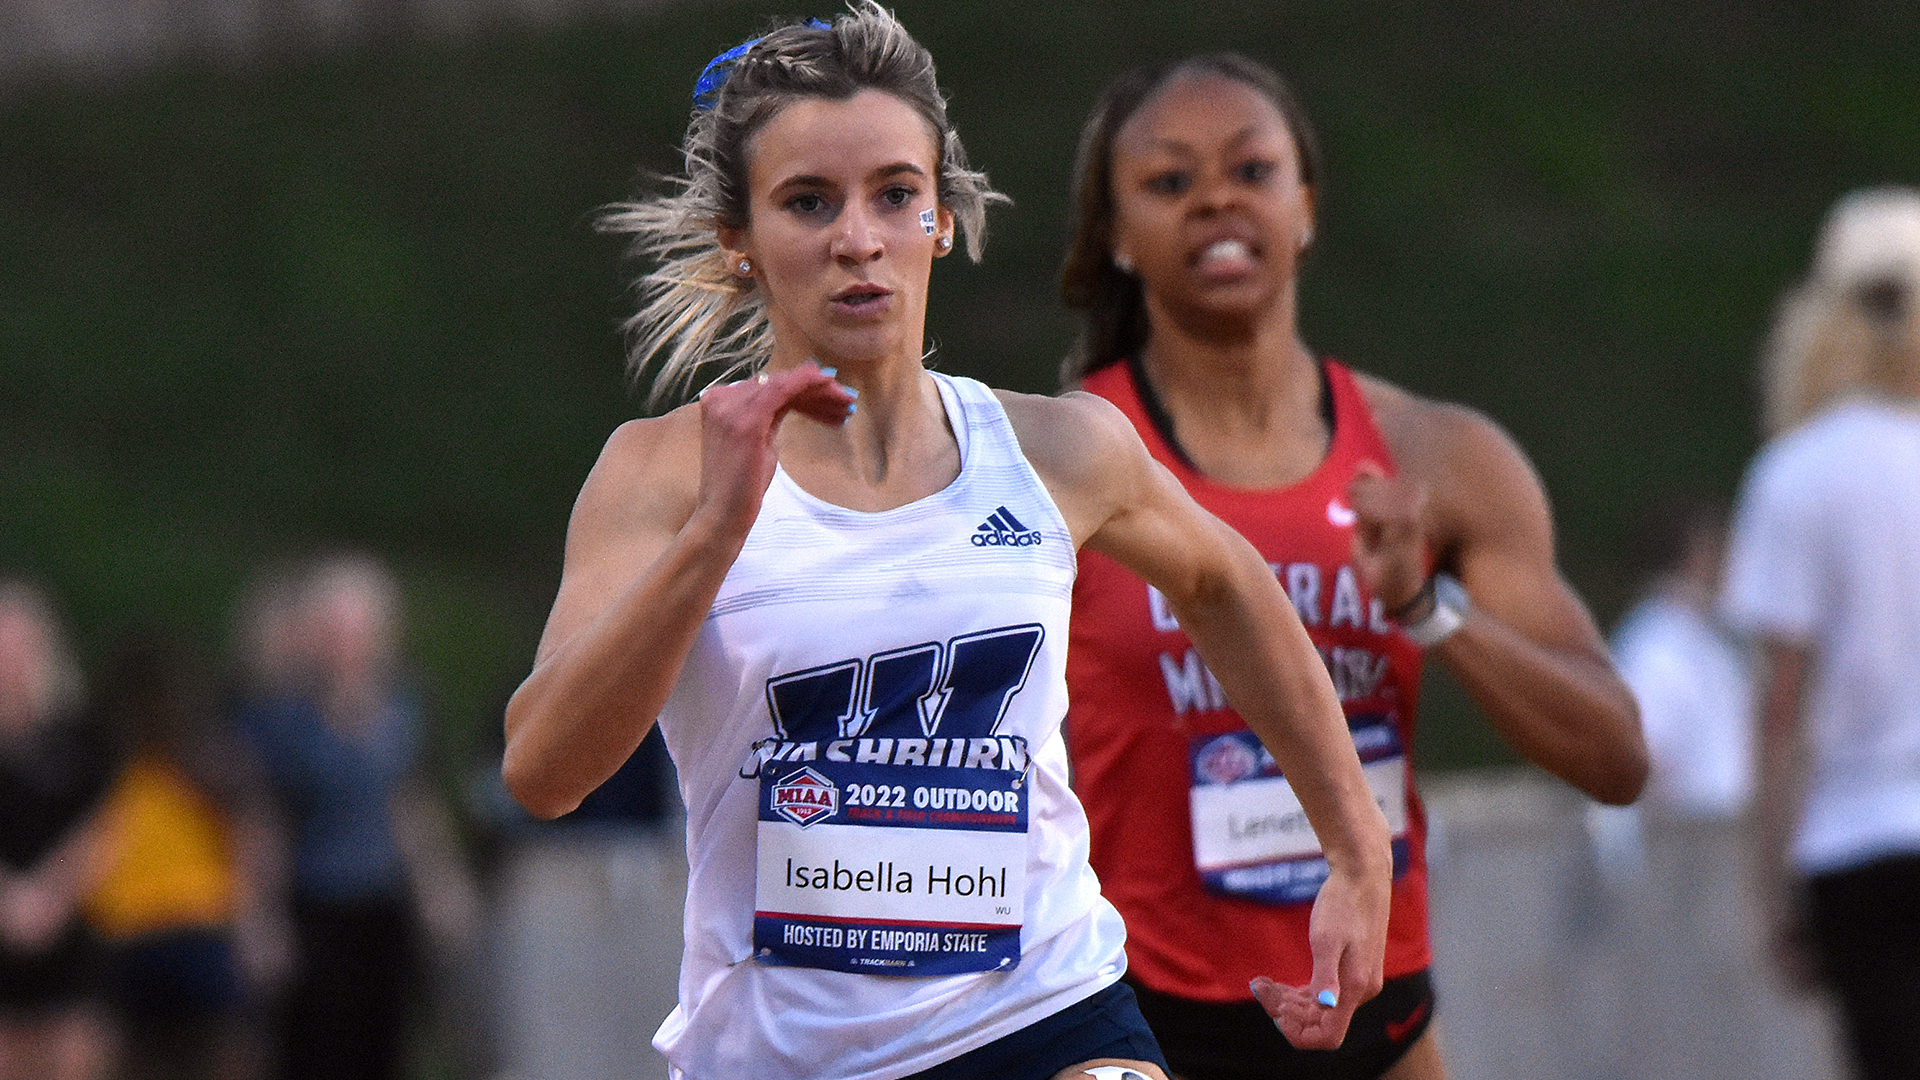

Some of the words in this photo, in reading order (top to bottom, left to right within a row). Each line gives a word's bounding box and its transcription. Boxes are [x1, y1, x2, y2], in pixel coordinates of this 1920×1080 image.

[971, 529, 1042, 547] adidas
[777, 788, 833, 807] MIAA
[845, 783, 906, 808] 2022
[913, 786, 1019, 813] OUTDOOR
[786, 857, 912, 893] Isabella
[928, 865, 1006, 898] Hohl
[995, 906, 1011, 916] WU
[784, 924, 841, 948] HOSTED
[847, 928, 867, 950] BY
[871, 930, 940, 953] EMPORIA
[942, 934, 988, 953] STATE
